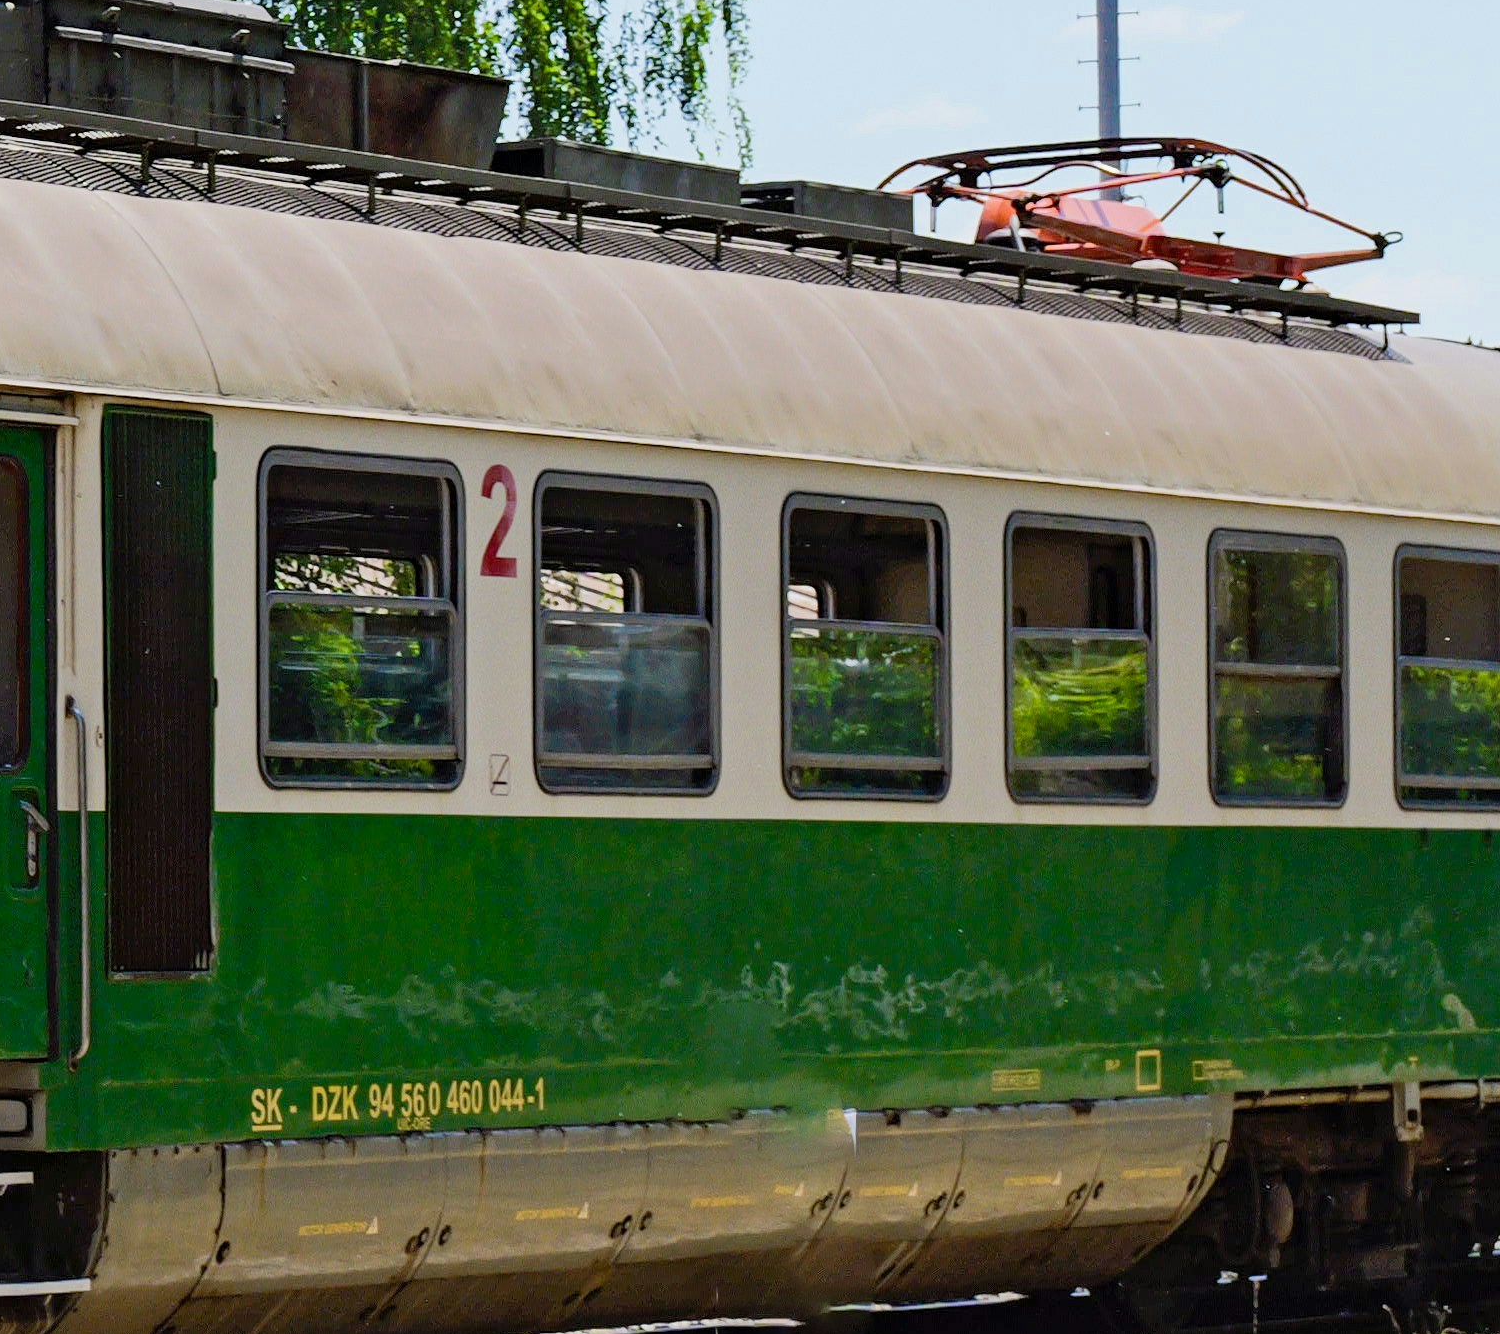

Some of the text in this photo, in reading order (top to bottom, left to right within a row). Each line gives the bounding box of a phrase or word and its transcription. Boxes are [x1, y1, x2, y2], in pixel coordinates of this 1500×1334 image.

[480, 464, 517, 578] 2
[251, 1088, 283, 1128] SK
[311, 1084, 359, 1123] DZK
[368, 1083, 394, 1119] 94
[446, 1079, 483, 1115] 460
[488, 1076, 545, 1114] 044-1
